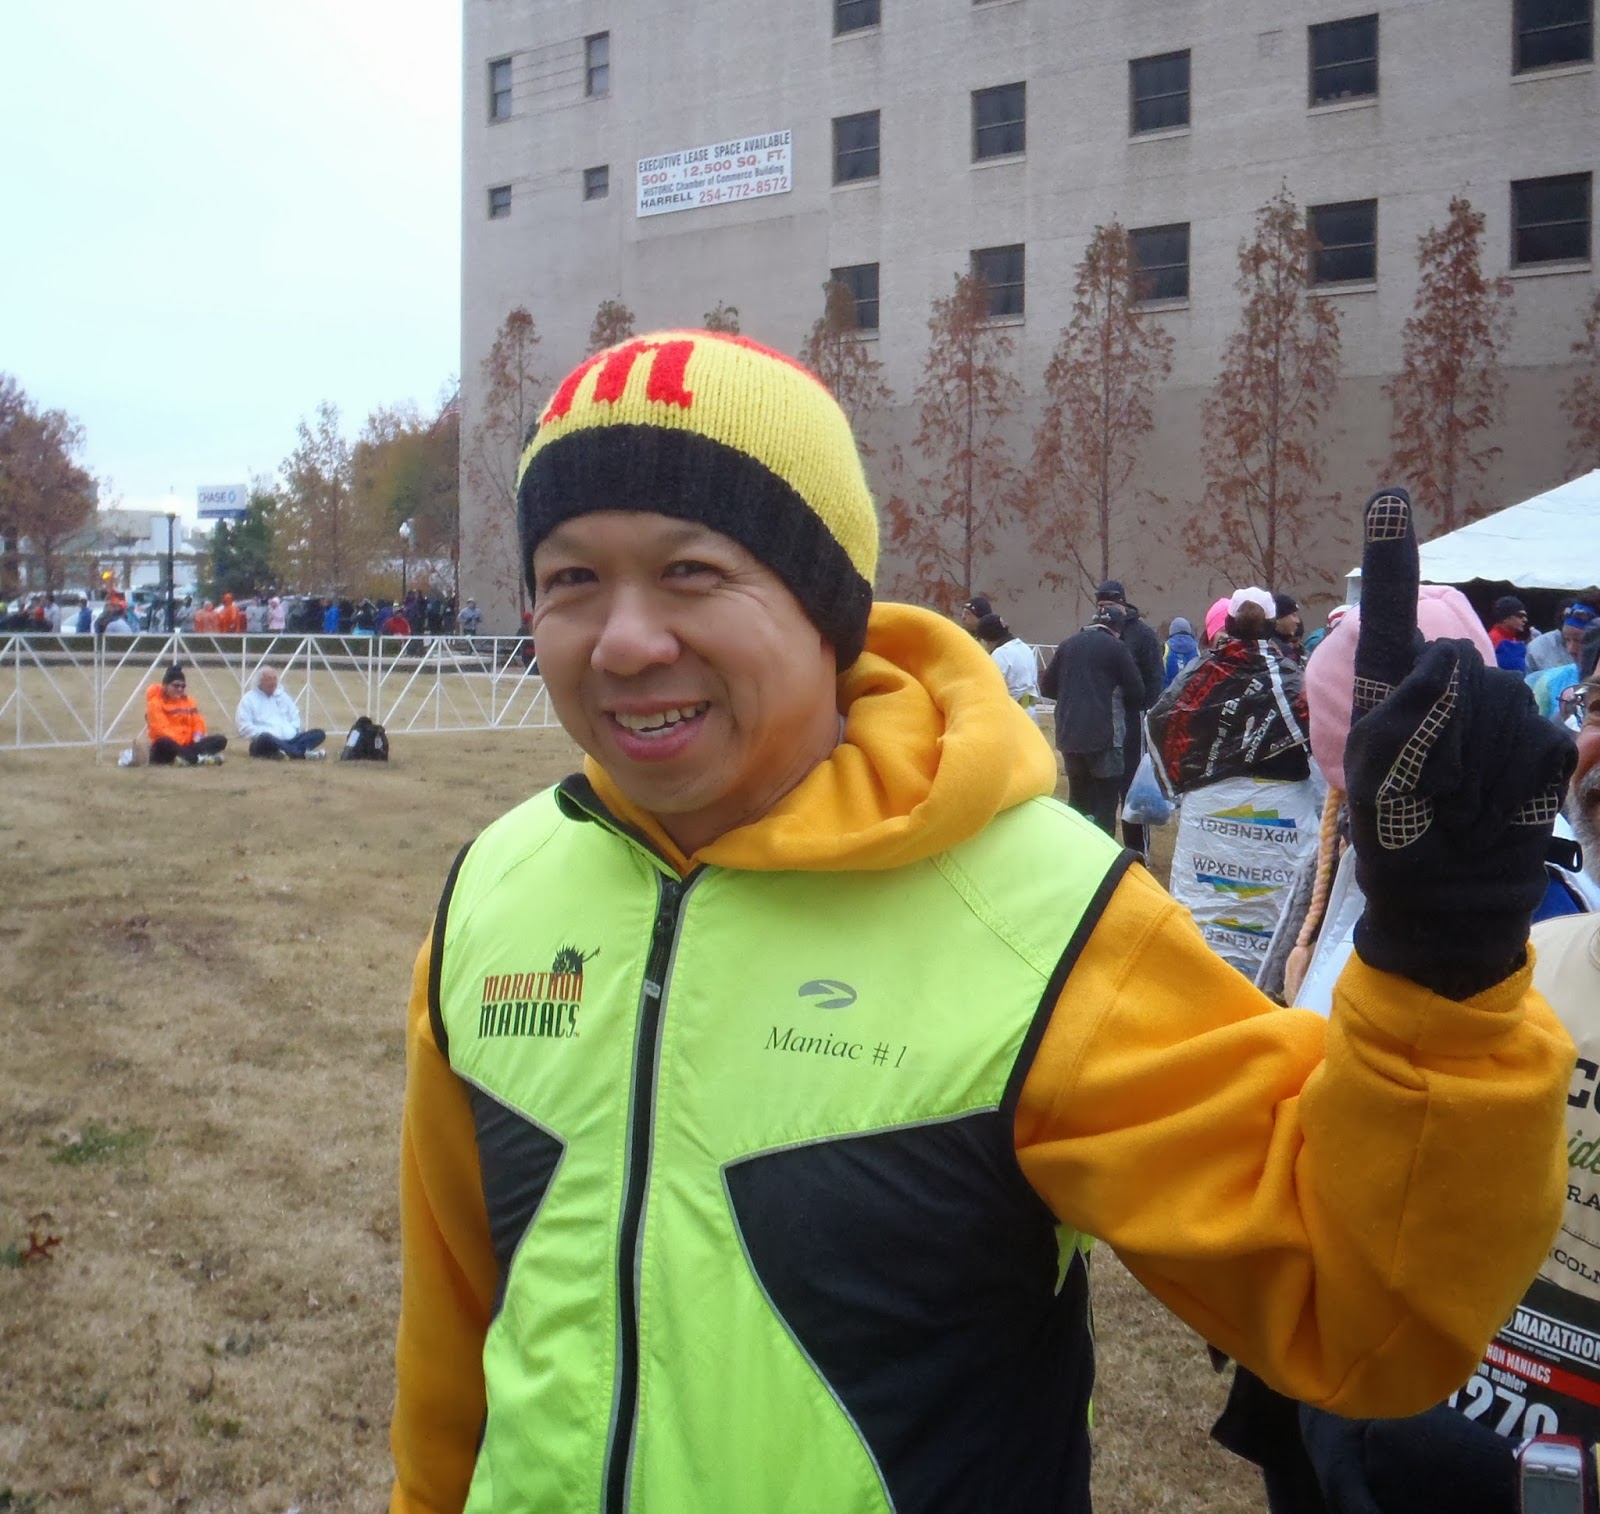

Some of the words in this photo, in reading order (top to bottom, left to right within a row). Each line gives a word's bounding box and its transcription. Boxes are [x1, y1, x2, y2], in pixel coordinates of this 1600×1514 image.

[639, 154, 681, 173] EXECUTIVE
[684, 149, 708, 164] LEASE
[714, 142, 741, 158] SPACE
[744, 132, 790, 152] AVAILABLE
[642, 172, 668, 186] 500
[737, 154, 761, 168] SQ.
[767, 148, 786, 162] FT.
[641, 191, 693, 208] HARRELL
[700, 176, 788, 203] 254-772-8572
[643, 183, 674, 197] HISTORIC
[676, 179, 705, 191] Chamber
[716, 170, 753, 184] Commerce
[755, 165, 784, 178] Building
[199, 491, 227, 504] CHASE
[1192, 857, 1295, 883] WPXENERGY
[482, 972, 584, 1003] MARATHON
[478, 1001, 580, 1039] MANIACS
[764, 1026, 863, 1060] Maniac
[1485, 1343, 1506, 1365] HON
[1507, 1352, 1551, 1384] MANIACS
[1448, 1375, 1559, 1447] 270
